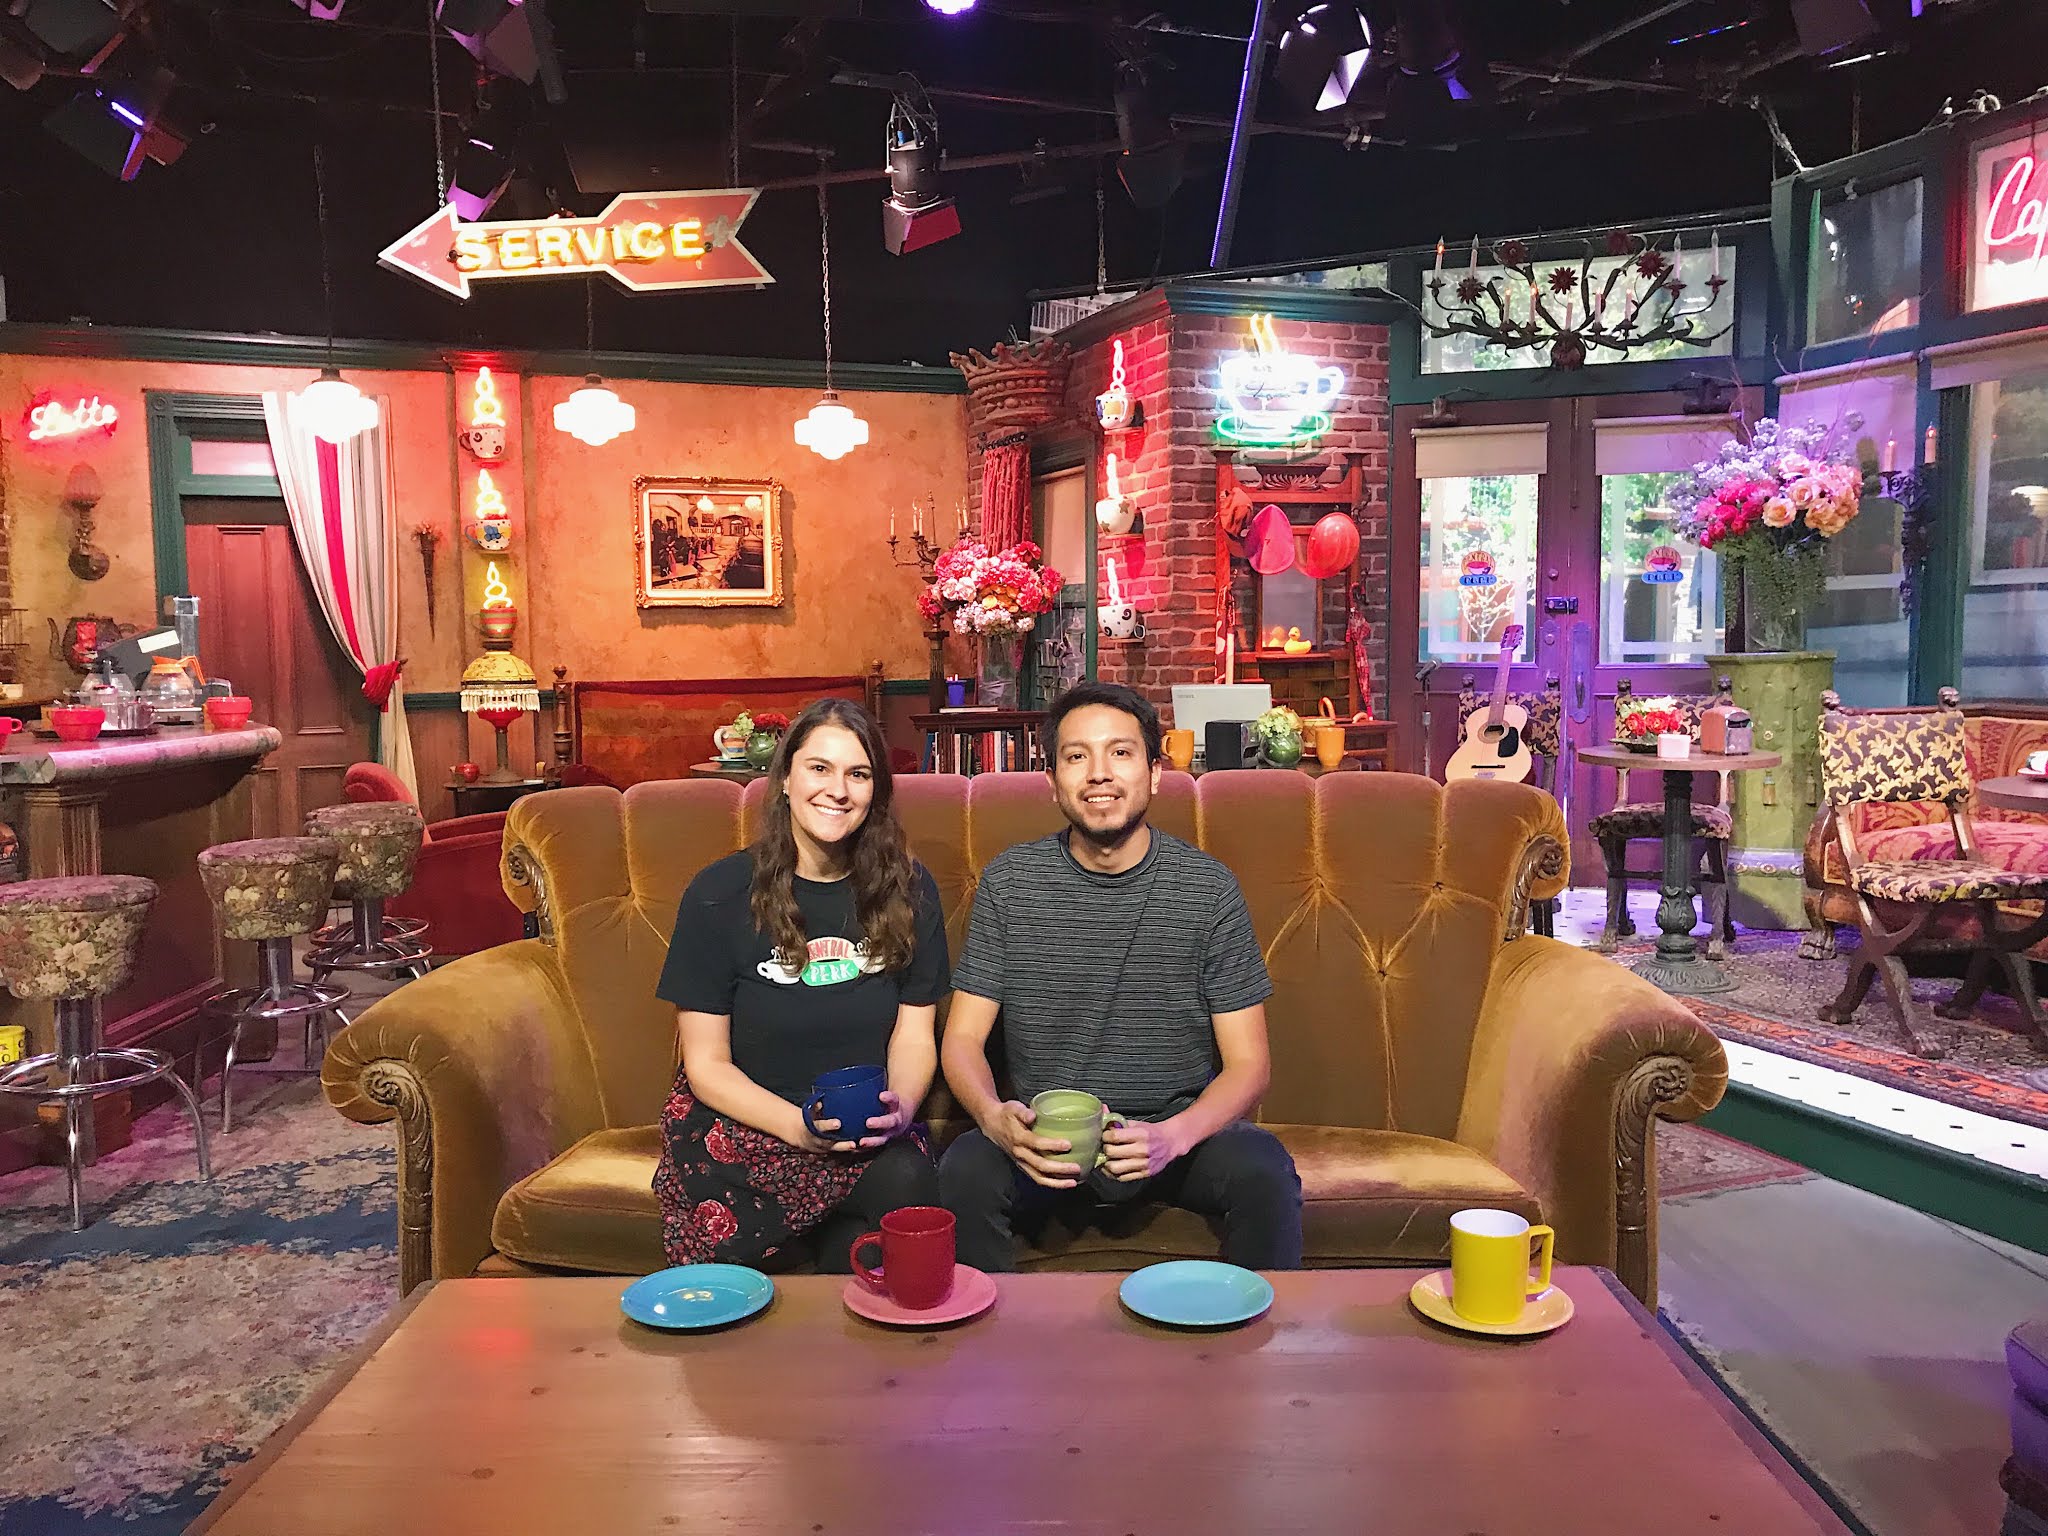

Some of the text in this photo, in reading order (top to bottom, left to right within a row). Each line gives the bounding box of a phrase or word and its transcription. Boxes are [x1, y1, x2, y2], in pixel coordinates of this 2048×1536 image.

[454, 221, 704, 270] SERVICE
[29, 396, 117, 440] Latte
[807, 939, 849, 960] ENTRAL
[810, 963, 853, 982] PERK
